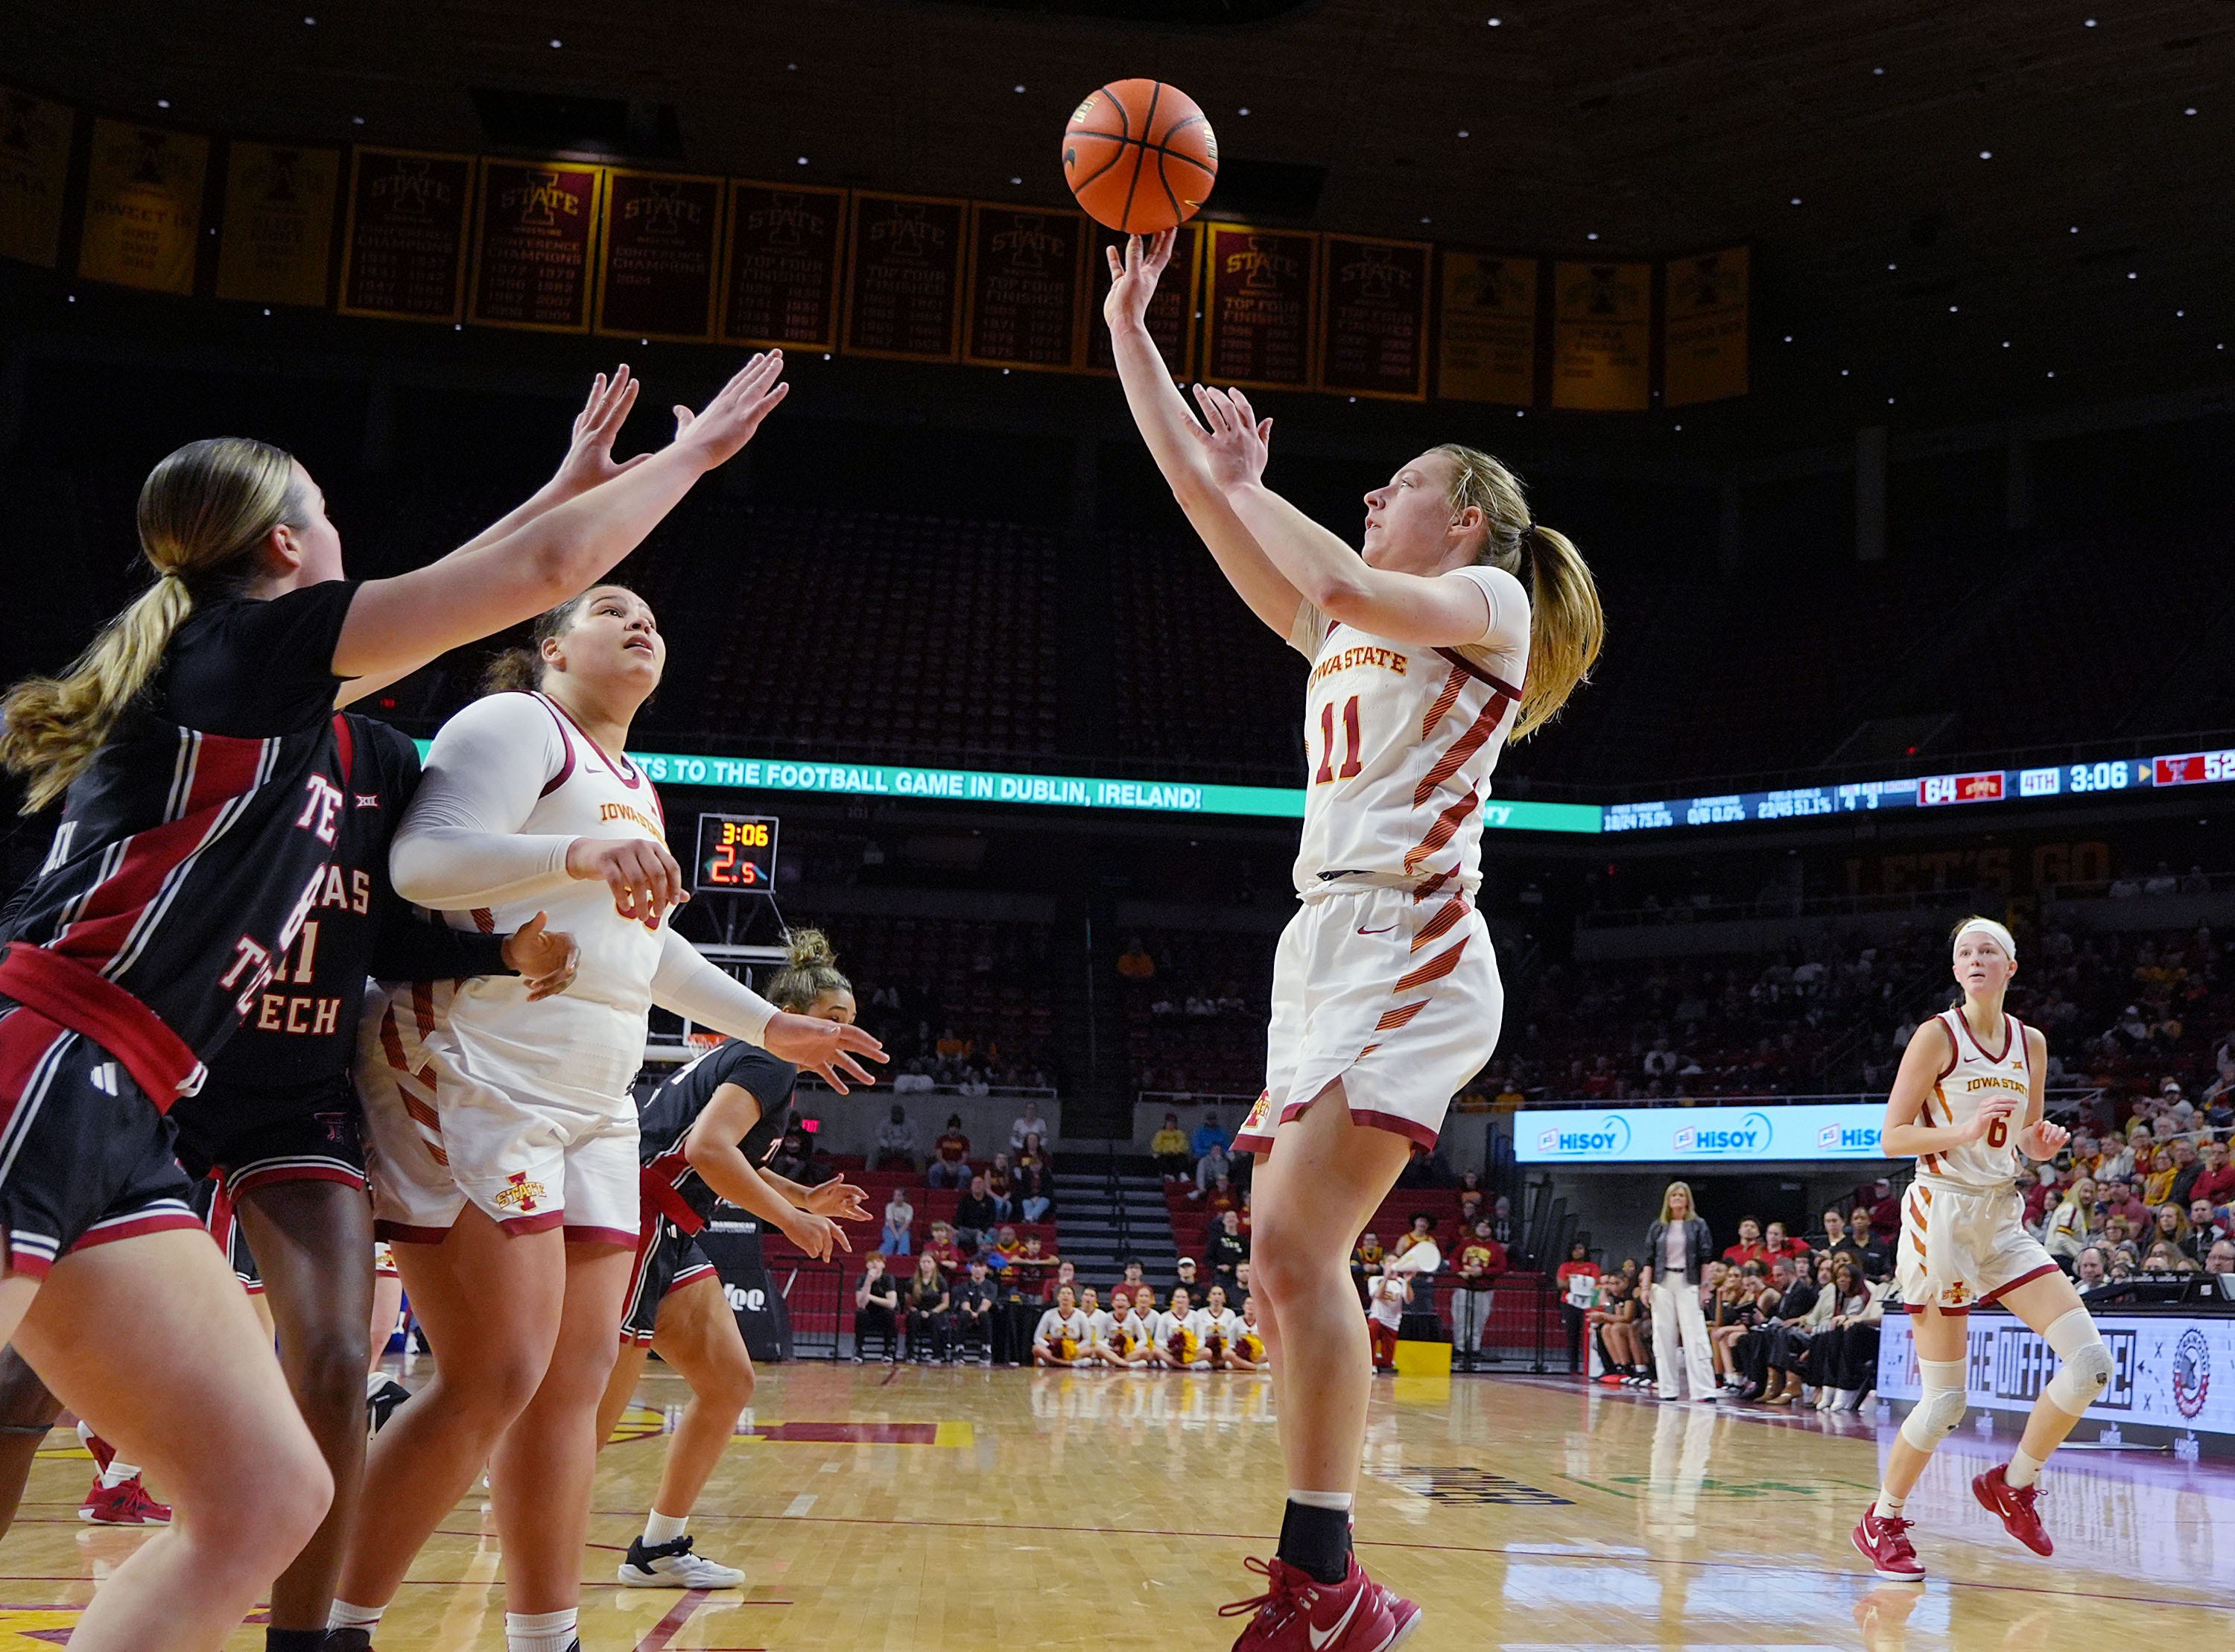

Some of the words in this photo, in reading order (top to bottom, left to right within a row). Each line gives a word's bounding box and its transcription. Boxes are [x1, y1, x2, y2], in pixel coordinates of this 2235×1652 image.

[371, 174, 451, 204] STATE
[501, 188, 580, 216] STATE
[624, 197, 703, 224] STATE
[747, 209, 824, 236] STATE
[358, 235, 452, 253] CHAMPIONS
[491, 237, 580, 252] CONFERENCE
[870, 219, 945, 248] STATE
[991, 230, 1065, 258] STATE
[487, 247, 581, 264] CHAMPIONS
[613, 258, 706, 274] CHAMPIONS
[1226, 252, 1298, 278] STATE
[1342, 262, 1412, 289] STATE
[1223, 310, 1299, 325] FINISHES
[1225, 297, 1254, 309] TOP
[1258, 299, 1299, 313] FOUR
[1310, 655, 1342, 693] OWA
[1345, 646, 1409, 676] STATE
[1316, 695, 1364, 786] 11
[2070, 761, 2128, 791] 3:06
[2204, 753, 2235, 780] 52
[637, 757, 668, 780] TS
[674, 758, 706, 782] TO
[714, 761, 760, 784] THE
[767, 765, 889, 792] FOOTBALL
[895, 771, 964, 796] GAME
[971, 775, 994, 798] IN
[1001, 778, 1091, 807] DUBLIN,
[1098, 783, 1202, 810] IRELAND!
[1924, 779, 1957, 803] 64
[2023, 772, 2056, 792] 4TH
[296, 772, 343, 844] TE
[600, 803, 639, 823] IOWA
[1845, 796, 1856, 810] 4
[1867, 793, 1878, 809] 3
[1483, 806, 1513, 825] ry
[722, 822, 768, 847] 3:06
[711, 844, 757, 884] 2.5
[322, 865, 370, 915] AS
[258, 993, 340, 1035] ECH
[1967, 1077, 2001, 1092] IOWA
[2001, 1078, 2027, 1098] STAT
[1986, 1108, 2012, 1149] 6
[495, 1181, 548, 1210] STATE
[1967, 1331, 1993, 1391] HE
